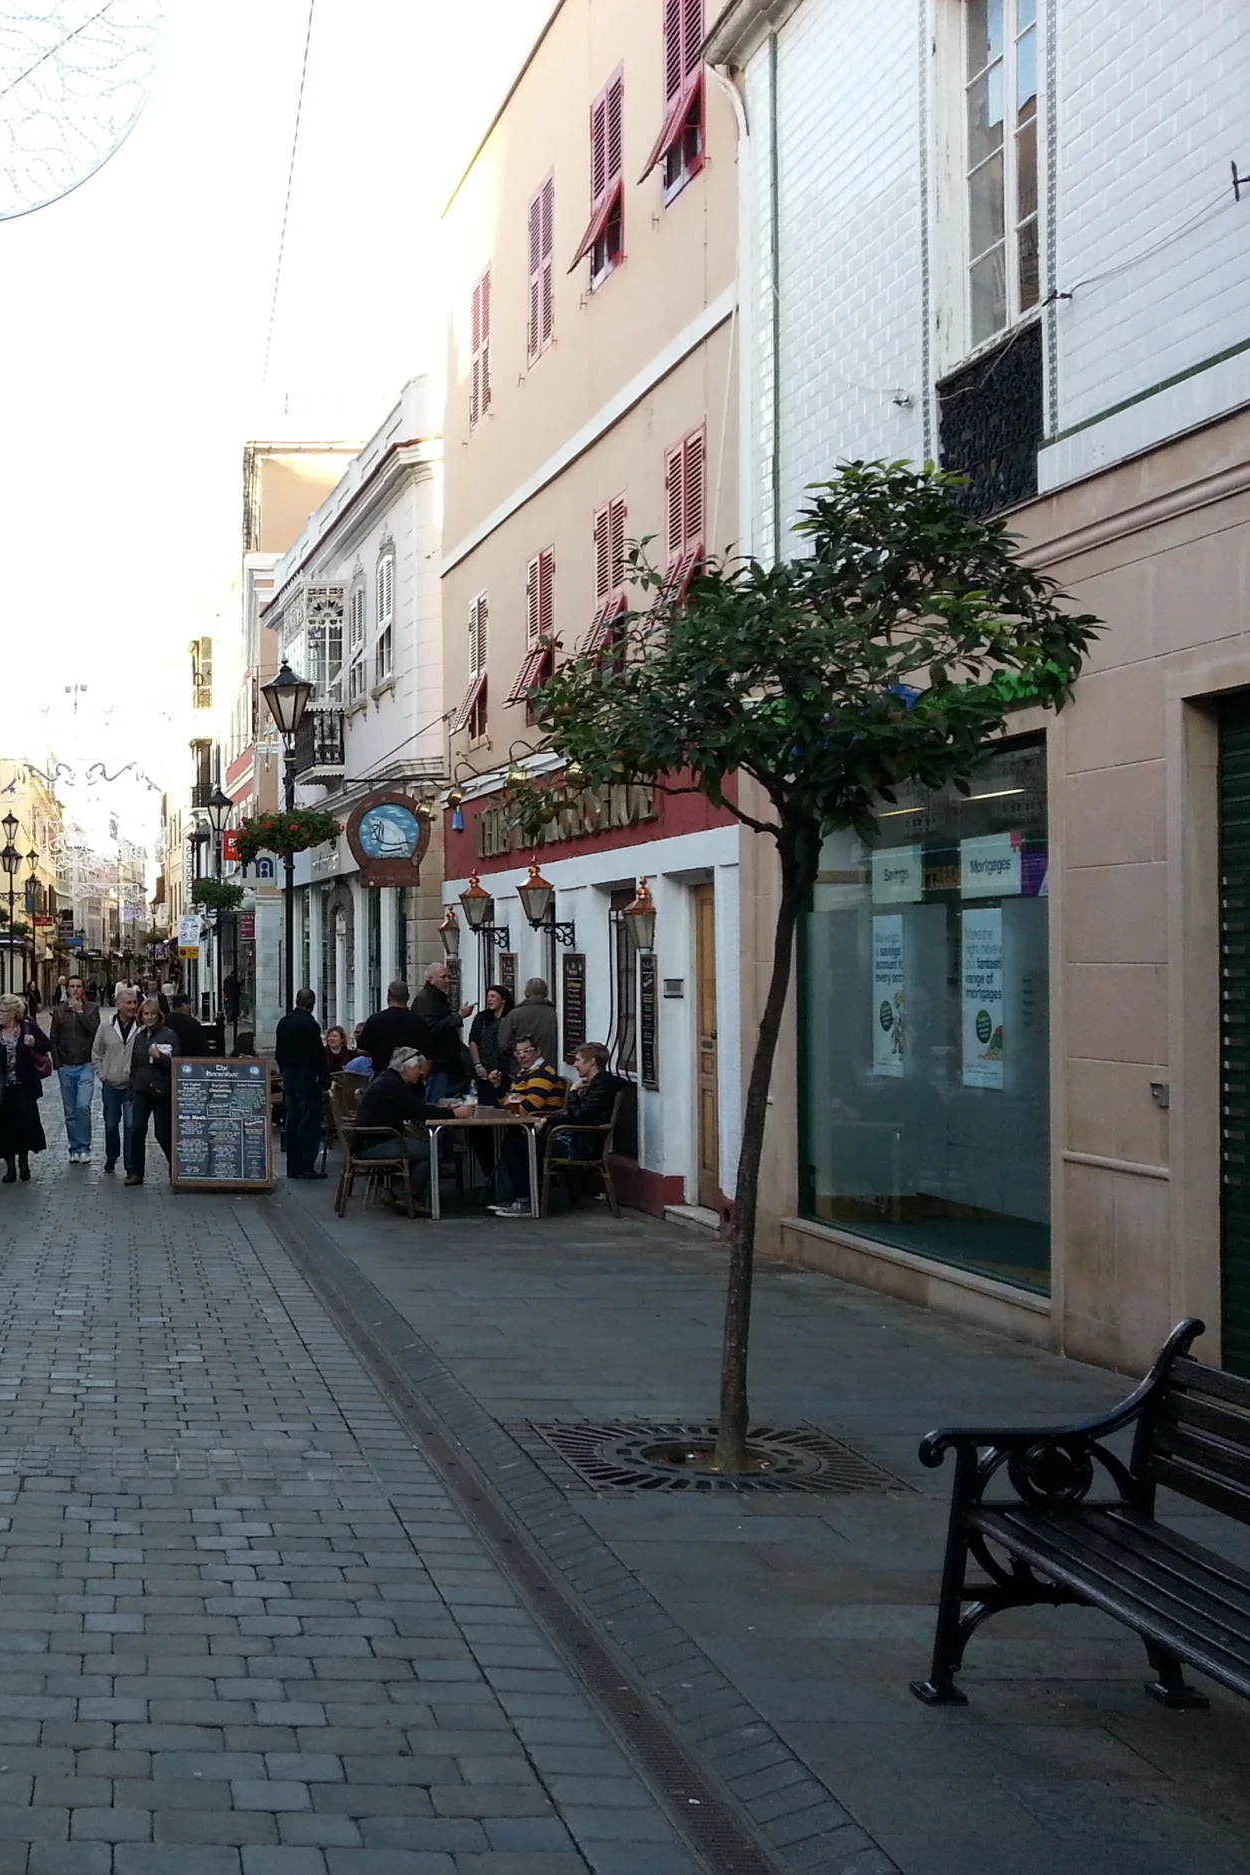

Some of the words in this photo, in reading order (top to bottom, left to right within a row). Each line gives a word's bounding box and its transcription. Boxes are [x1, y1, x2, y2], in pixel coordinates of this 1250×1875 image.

[969, 857, 1012, 875] Mortgages
[883, 867, 909, 883] Savings
[965, 974, 985, 987] range
[986, 973, 994, 984] of
[965, 988, 1003, 1002] mortgages
